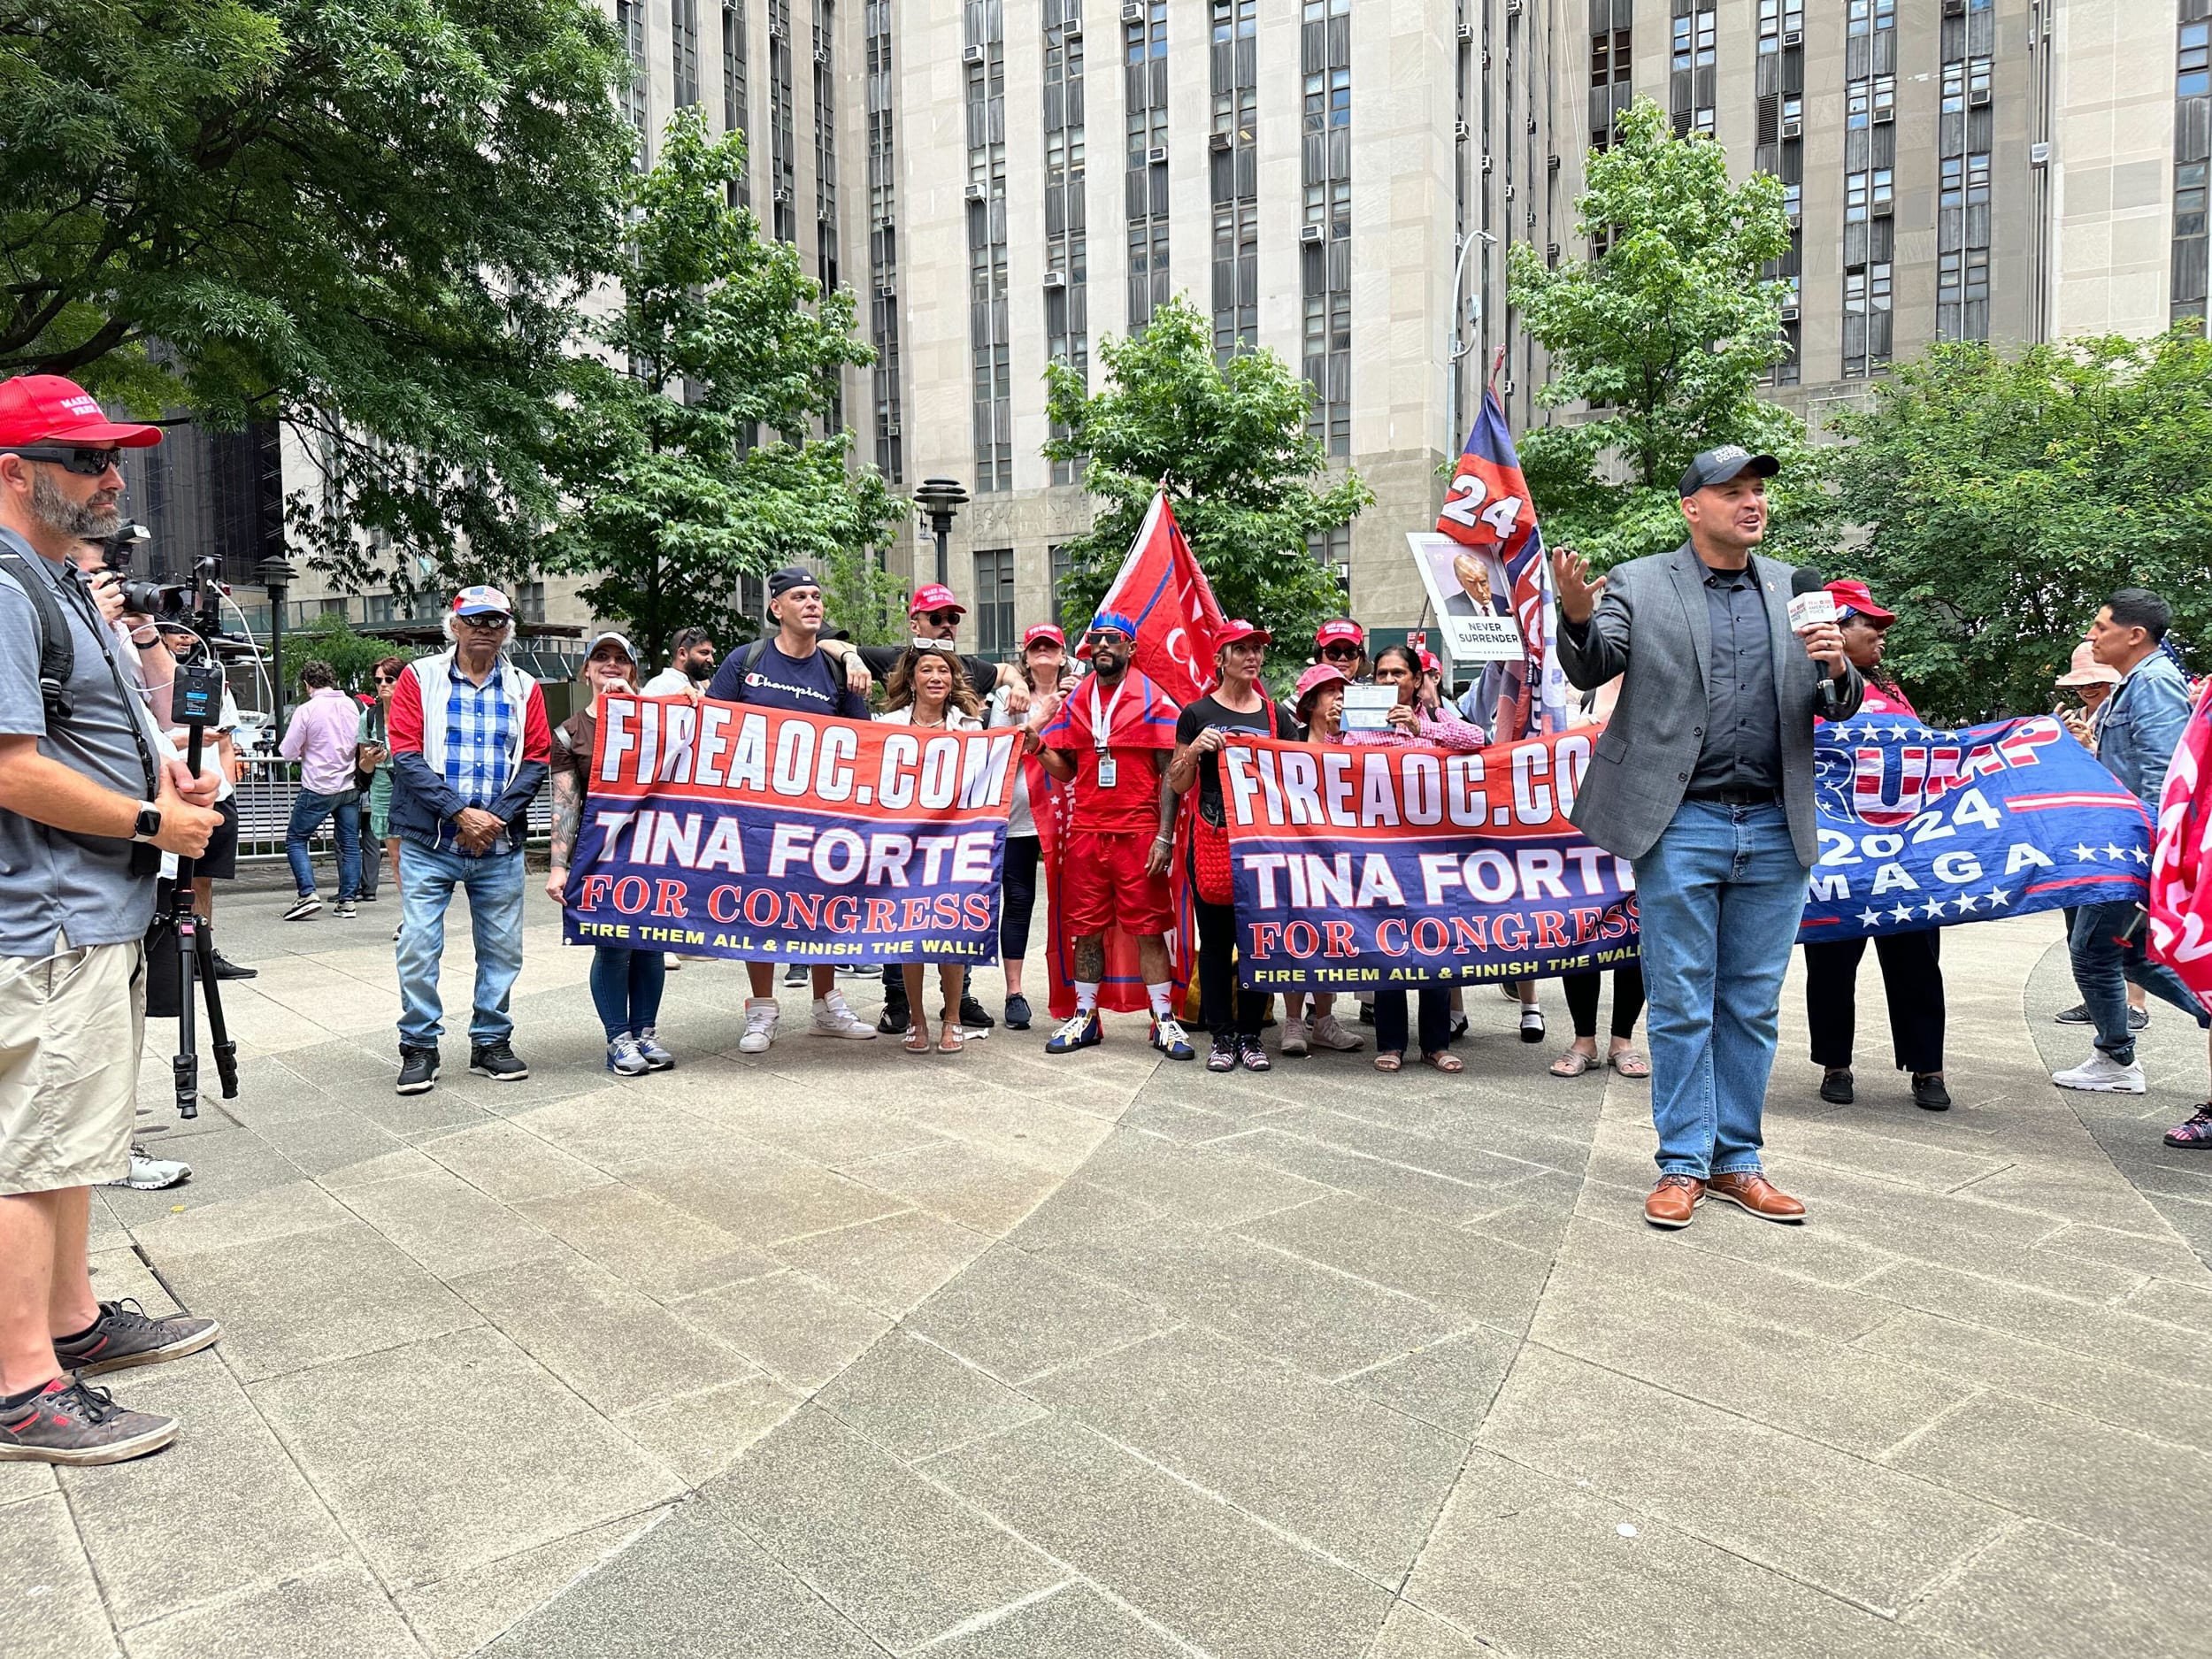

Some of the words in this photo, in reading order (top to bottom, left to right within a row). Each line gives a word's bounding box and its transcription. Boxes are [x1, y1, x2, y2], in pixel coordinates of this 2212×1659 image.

[1442, 473, 1523, 539] 24
[1459, 634, 1519, 643] SURRENDER
[1468, 622, 1502, 632] NEVER
[745, 672, 830, 702] Champion
[601, 696, 1016, 810] FIREAOC.COM
[1225, 735, 1593, 828] FIREAOC.CO
[1814, 714, 2063, 828] RUMP
[595, 809, 747, 874] TINA
[766, 822, 996, 888] FORTE
[1816, 787, 2002, 867] 2024
[1242, 853, 1407, 909] TINA
[1806, 843, 2055, 904] MAGA
[577, 874, 688, 918] FOR
[708, 884, 991, 935] CONGRESS
[580, 922, 631, 938] FIRE
[638, 926, 705, 945] THEM
[713, 933, 754, 950] ALL
[762, 939, 778, 953] &
[786, 941, 864, 956] FINISH
[872, 940, 914, 954] THE
[922, 940, 985, 956] WALL!
[1248, 920, 1360, 960] FOR
[1254, 969, 1307, 983] FIRE
[1314, 968, 1379, 982] THEM
[1388, 967, 1430, 981] ALL
[1438, 966, 1453, 979] &
[1462, 961, 1539, 979] FINISH
[1547, 955, 1590, 972] THE
